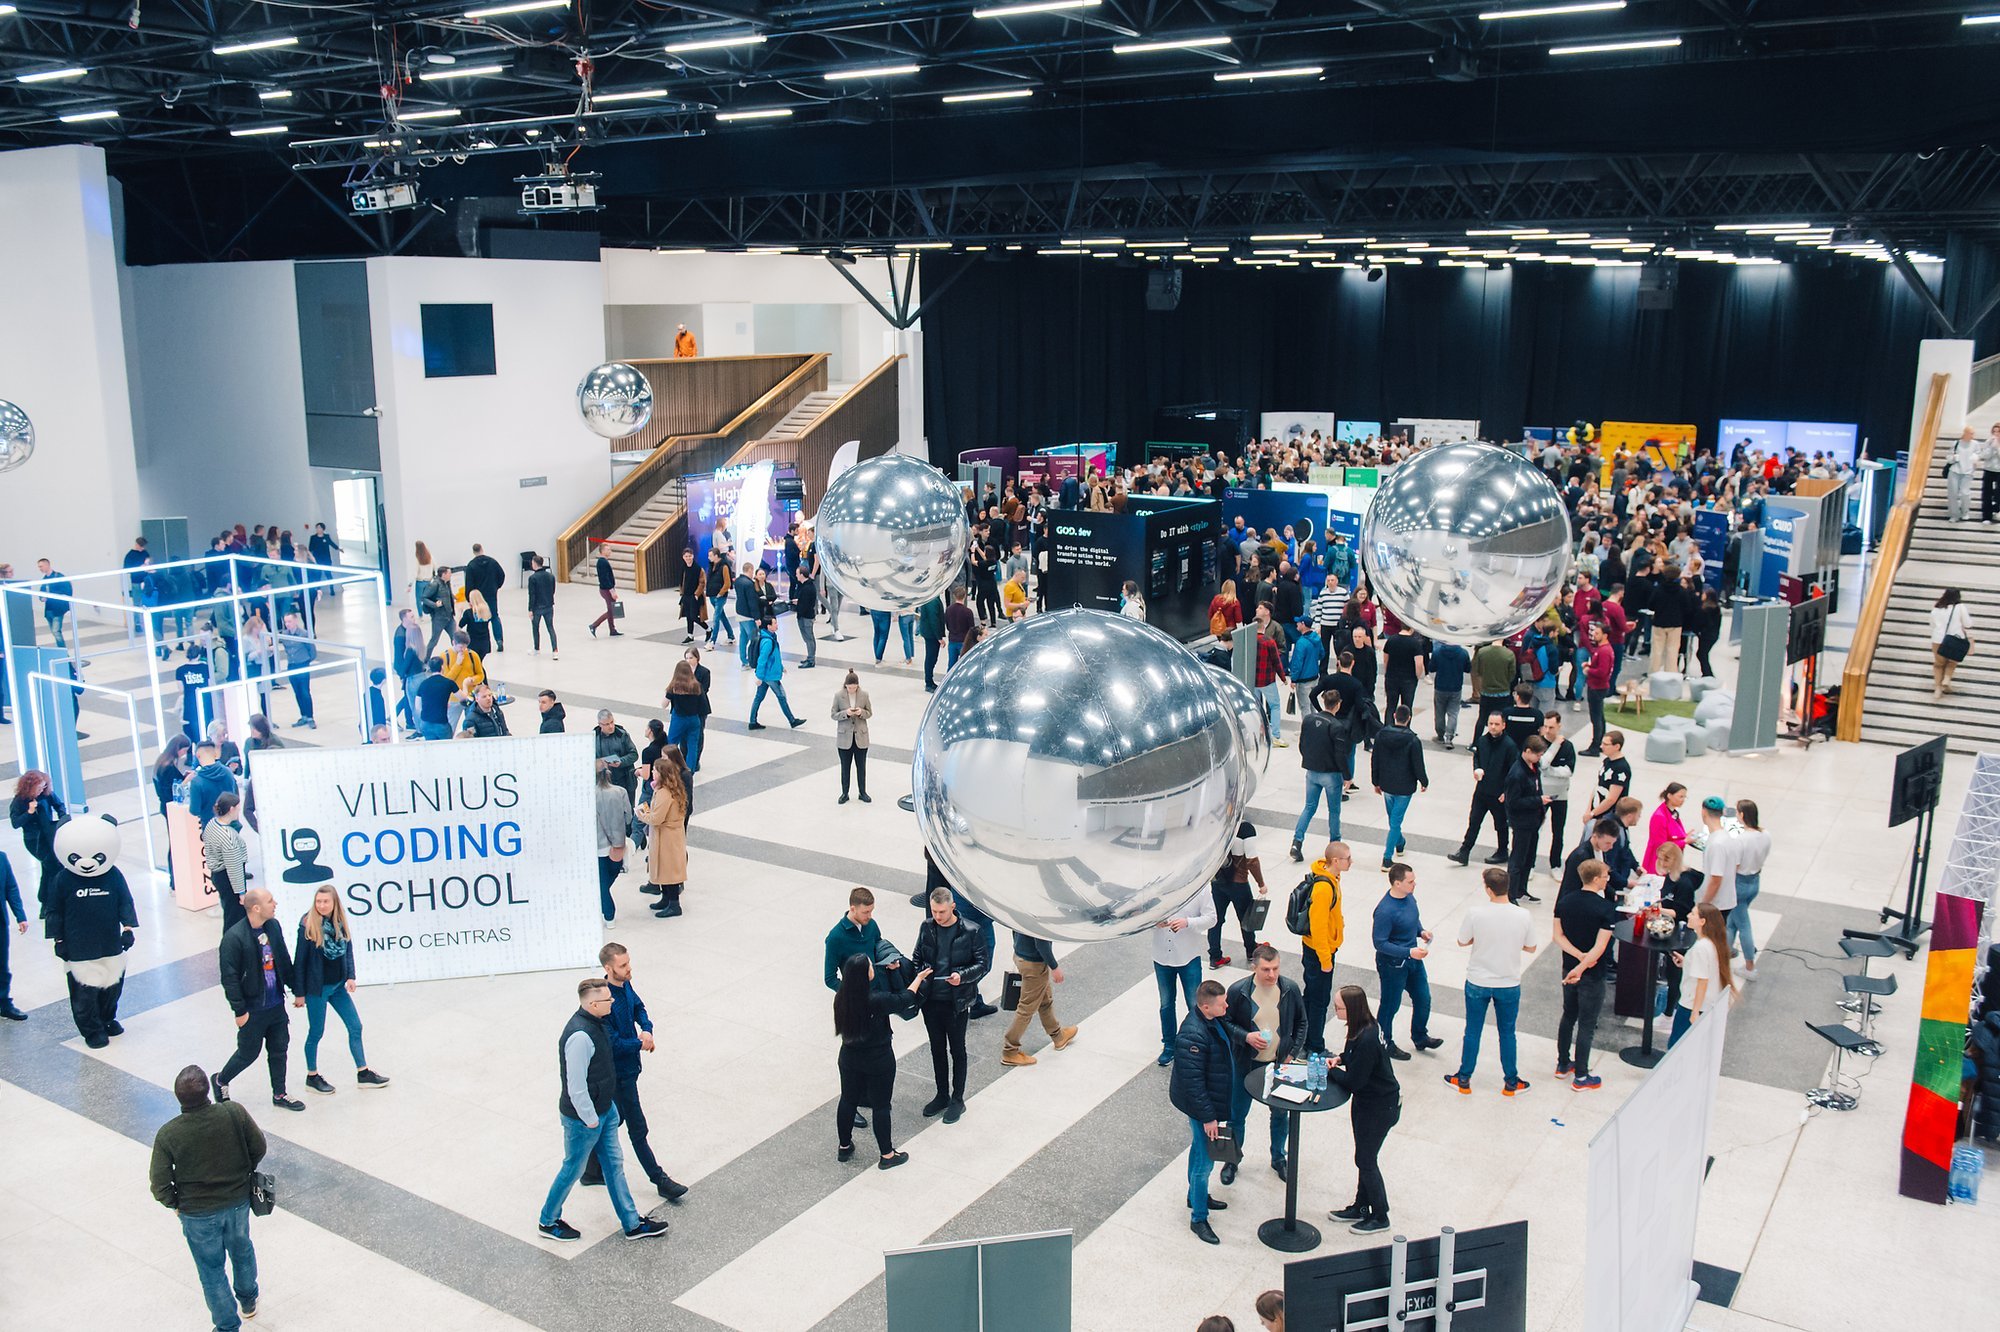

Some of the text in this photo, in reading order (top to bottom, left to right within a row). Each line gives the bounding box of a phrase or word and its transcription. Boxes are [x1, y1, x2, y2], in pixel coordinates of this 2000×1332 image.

[1160, 529, 1168, 539] Do
[1169, 527, 1176, 537] IT
[1177, 524, 1189, 535] with
[336, 773, 519, 817] VILNIUS
[341, 821, 523, 867] CODING
[346, 872, 529, 916] SCHOOL
[366, 928, 512, 951] INFO CENTRAS
[1406, 1294, 1435, 1312] EXPO
